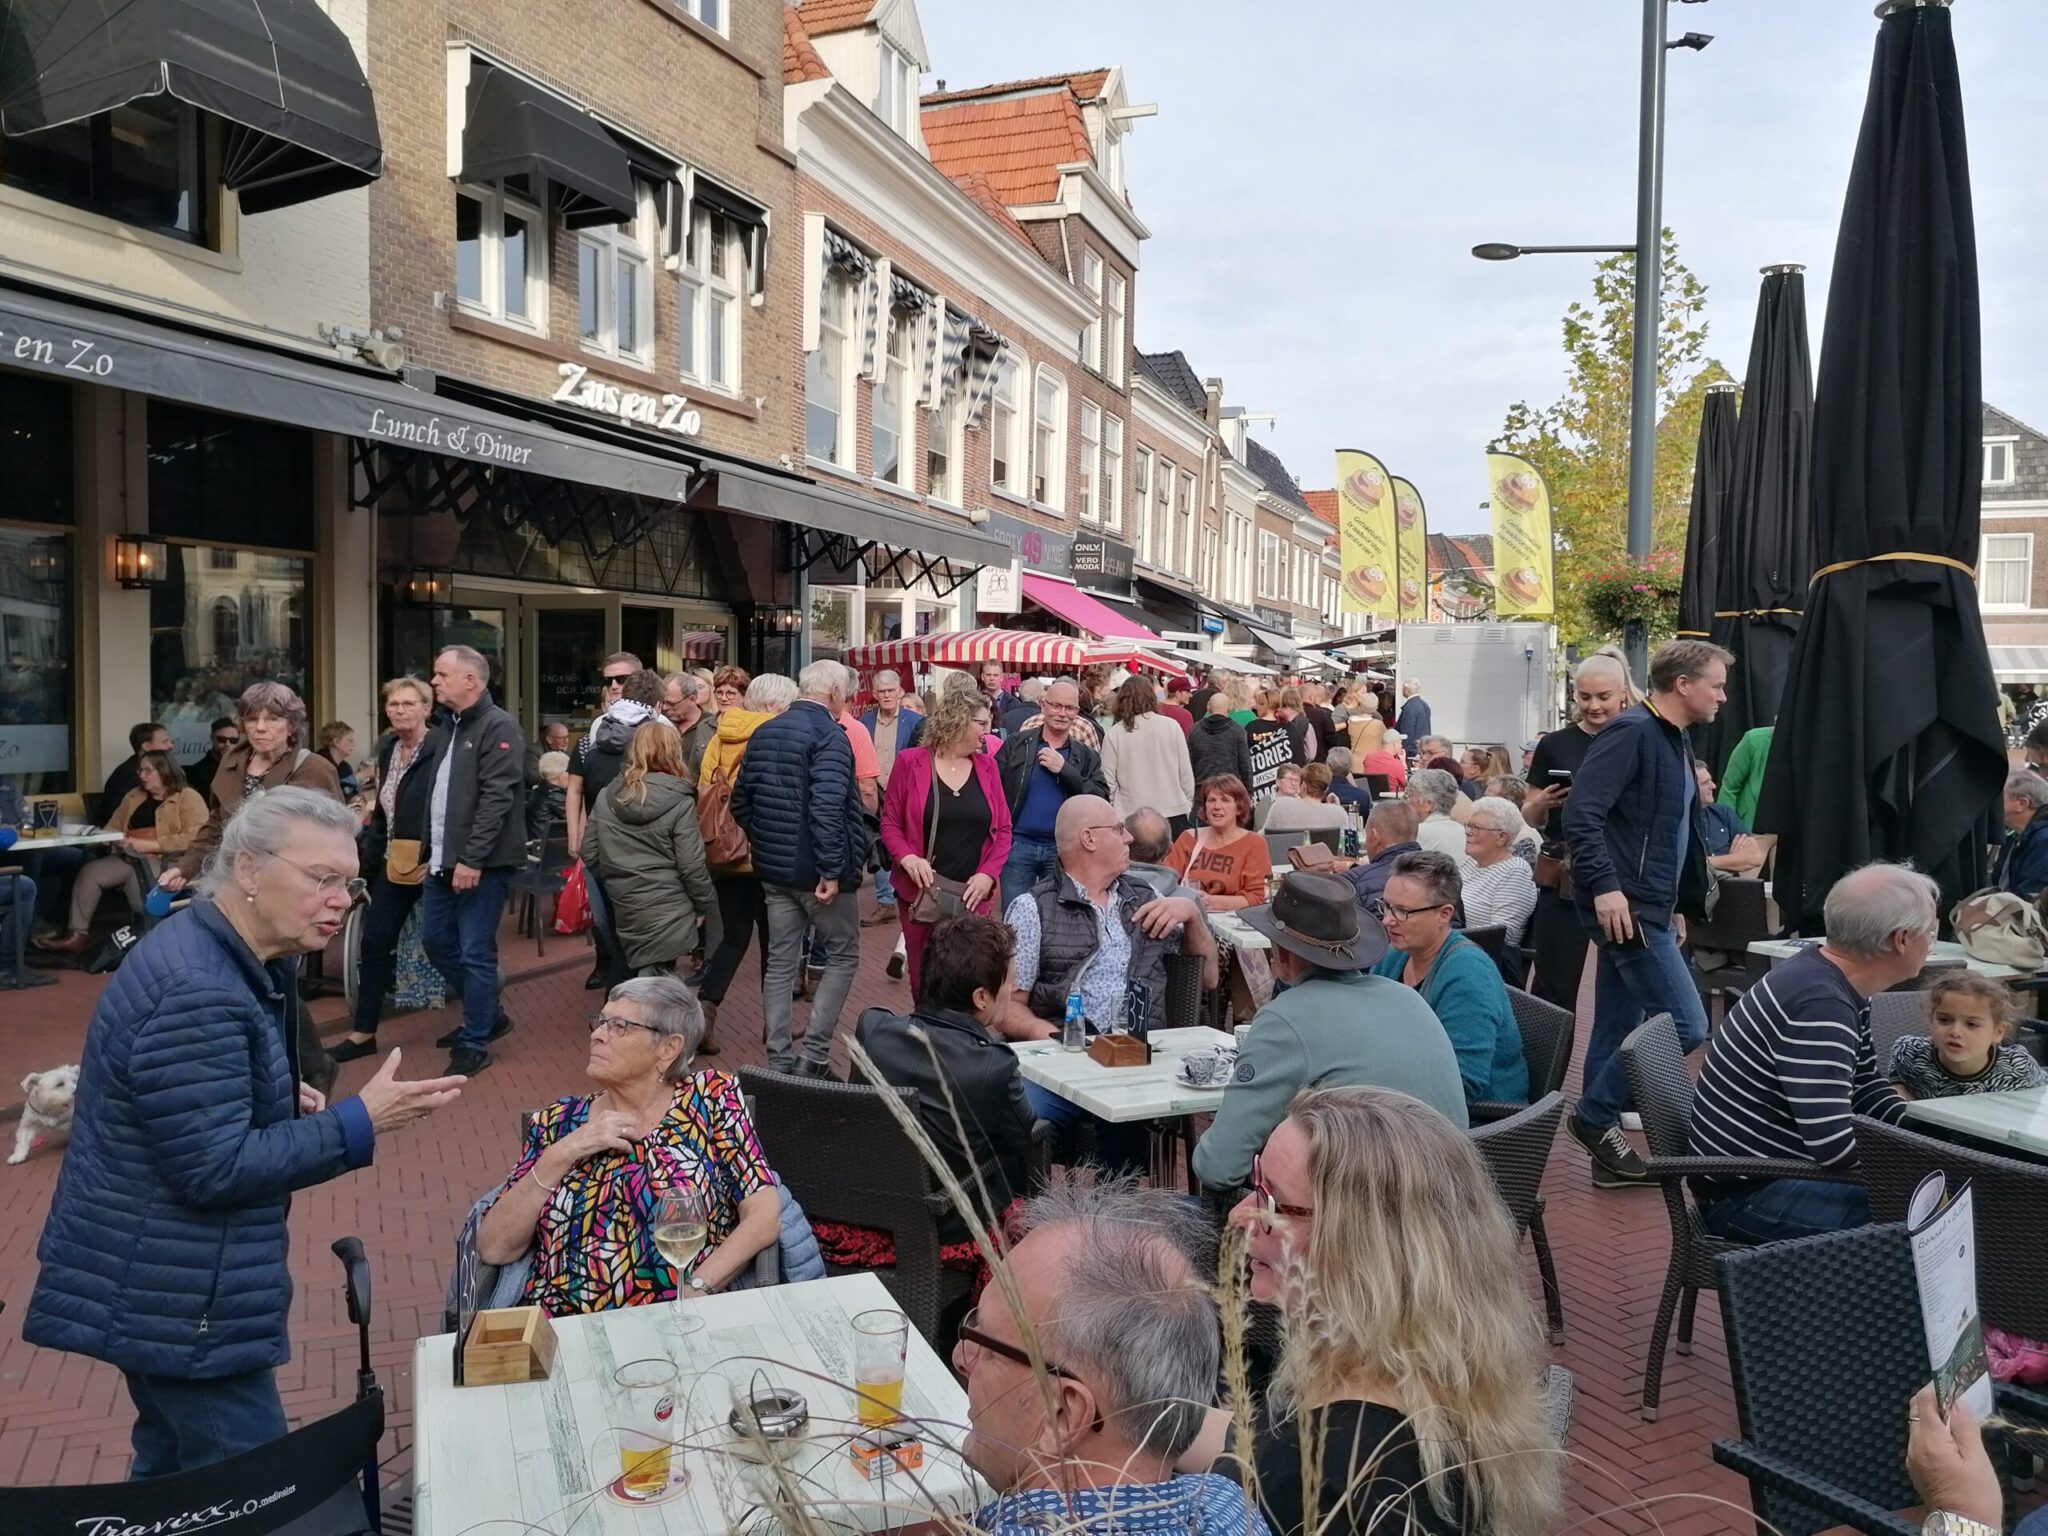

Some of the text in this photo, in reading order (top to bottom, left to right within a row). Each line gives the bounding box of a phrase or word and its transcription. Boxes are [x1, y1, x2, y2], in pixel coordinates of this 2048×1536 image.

[14, 336, 113, 376] en Zo
[552, 362, 700, 436] Zus en Zo
[368, 408, 532, 464] Lunch & Diner
[1023, 530, 1042, 564] 49
[1075, 556, 1099, 564] VERO
[1250, 739, 1294, 772] TORIES
[1128, 991, 1145, 1032] 37
[74, 1499, 234, 1536] Travixx
